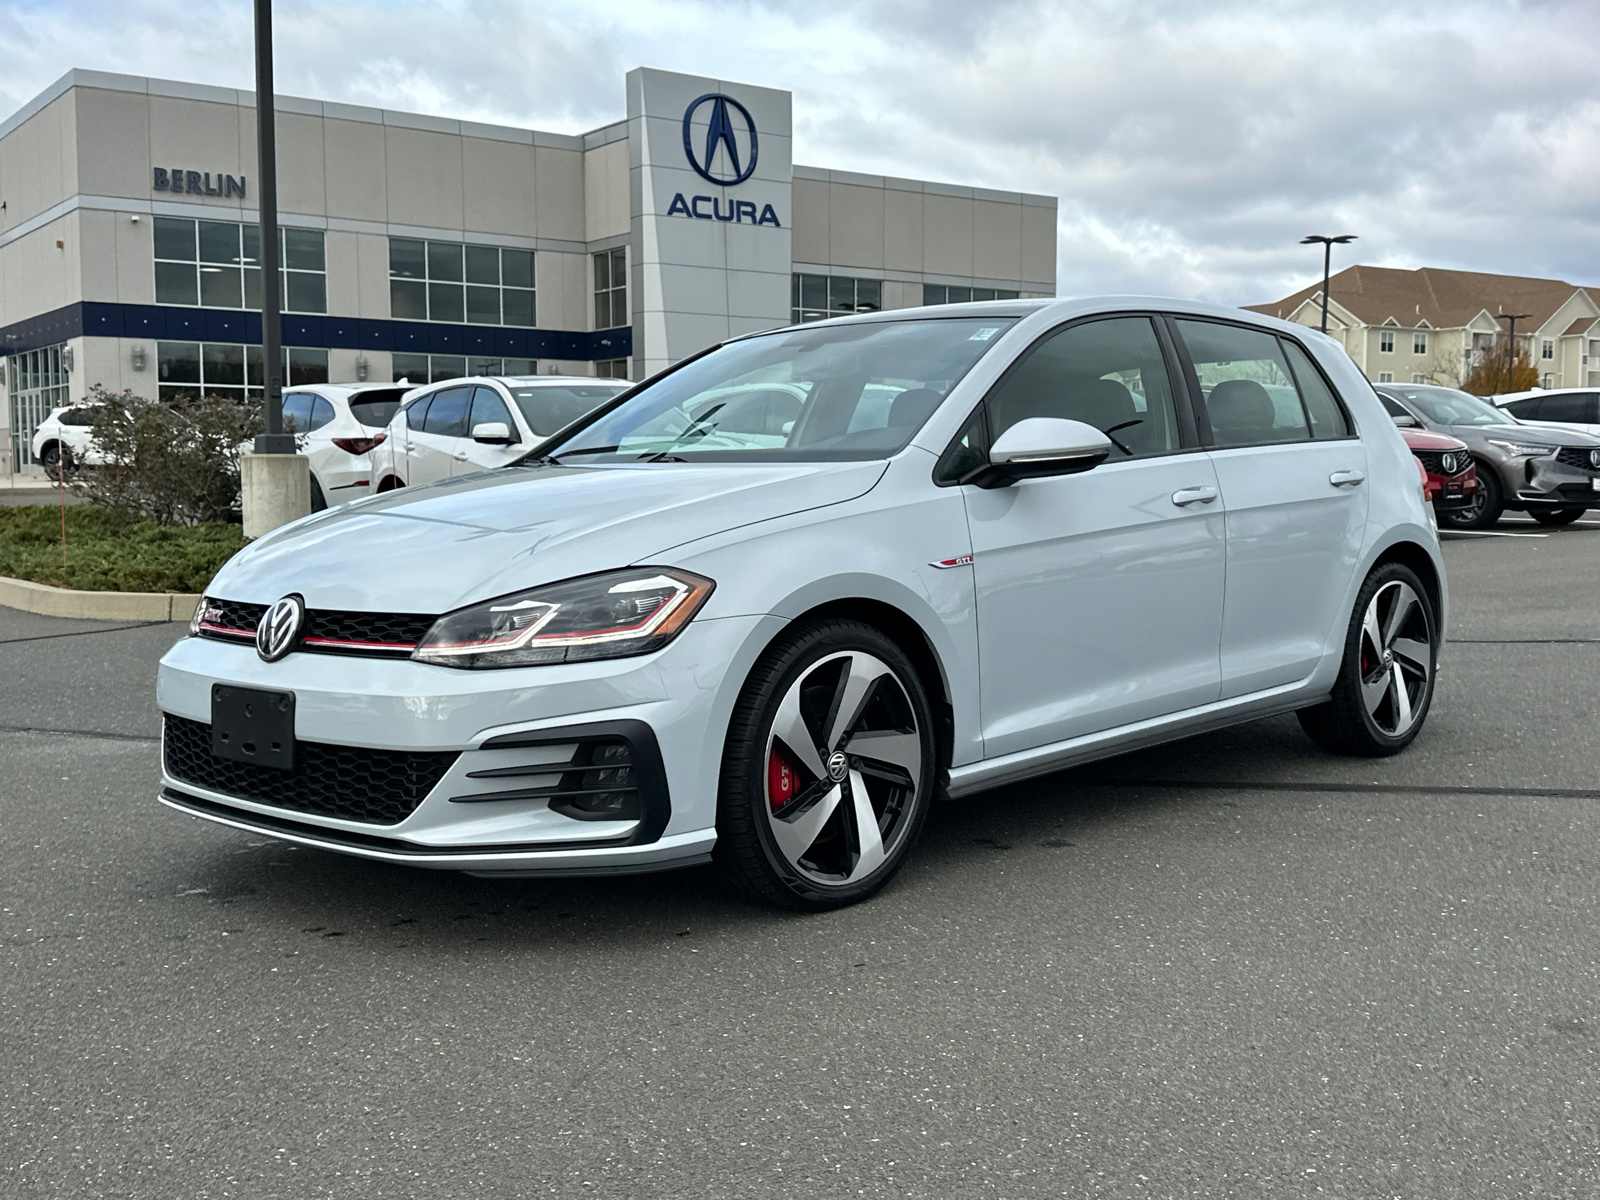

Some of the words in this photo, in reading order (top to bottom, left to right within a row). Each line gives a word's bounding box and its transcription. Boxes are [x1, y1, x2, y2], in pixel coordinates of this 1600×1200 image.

[153, 167, 246, 198] BERLIN
[667, 193, 781, 227] ACURA
[956, 557, 974, 566] GTI
